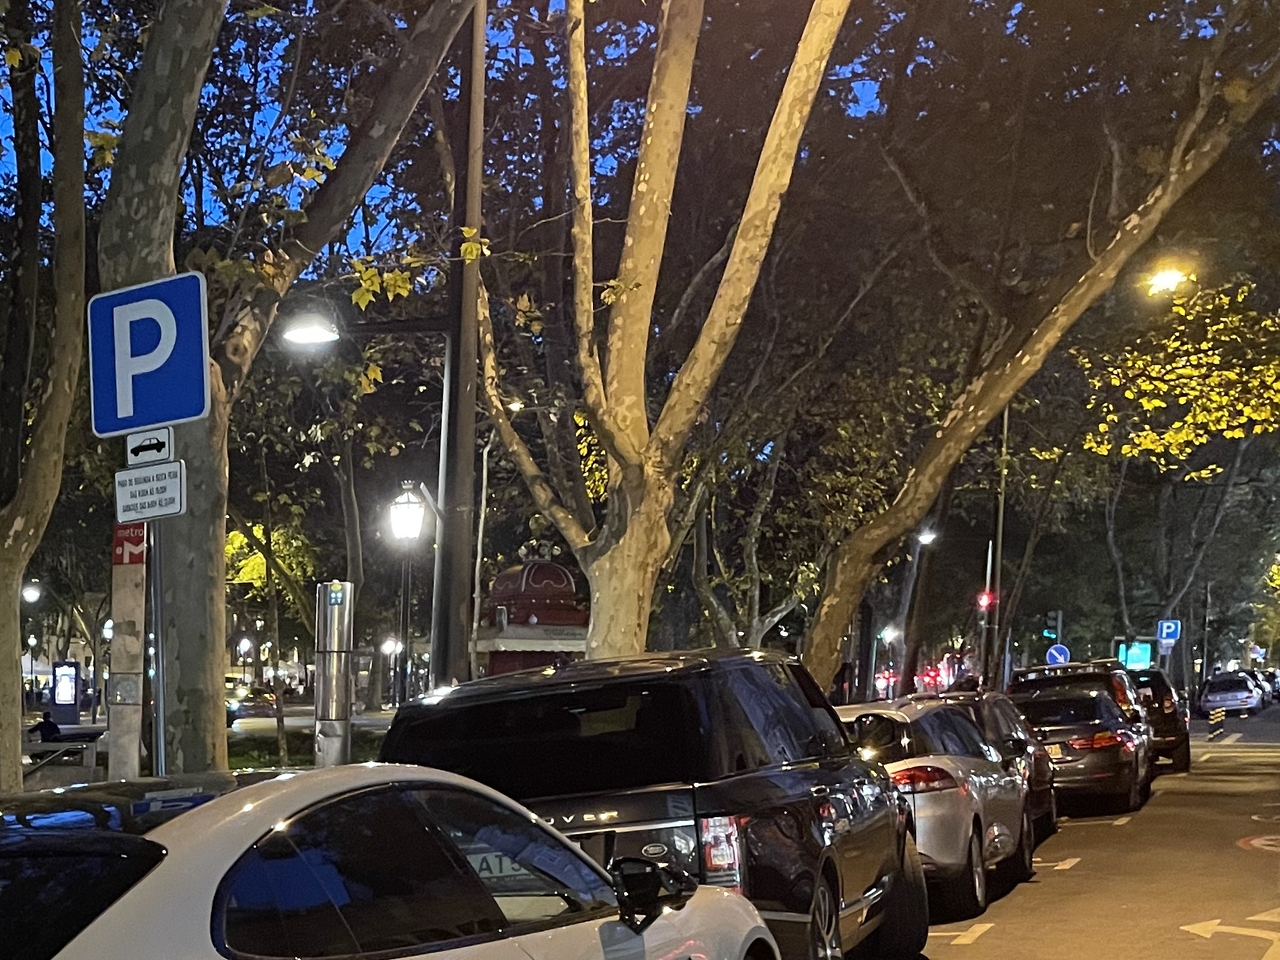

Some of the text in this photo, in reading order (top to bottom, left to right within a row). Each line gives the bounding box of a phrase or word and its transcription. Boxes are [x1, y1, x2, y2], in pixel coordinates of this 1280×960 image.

[113, 299, 178, 419] P
[117, 527, 144, 538] metro
[1162, 622, 1176, 639] P
[531, 811, 619, 826] OVER
